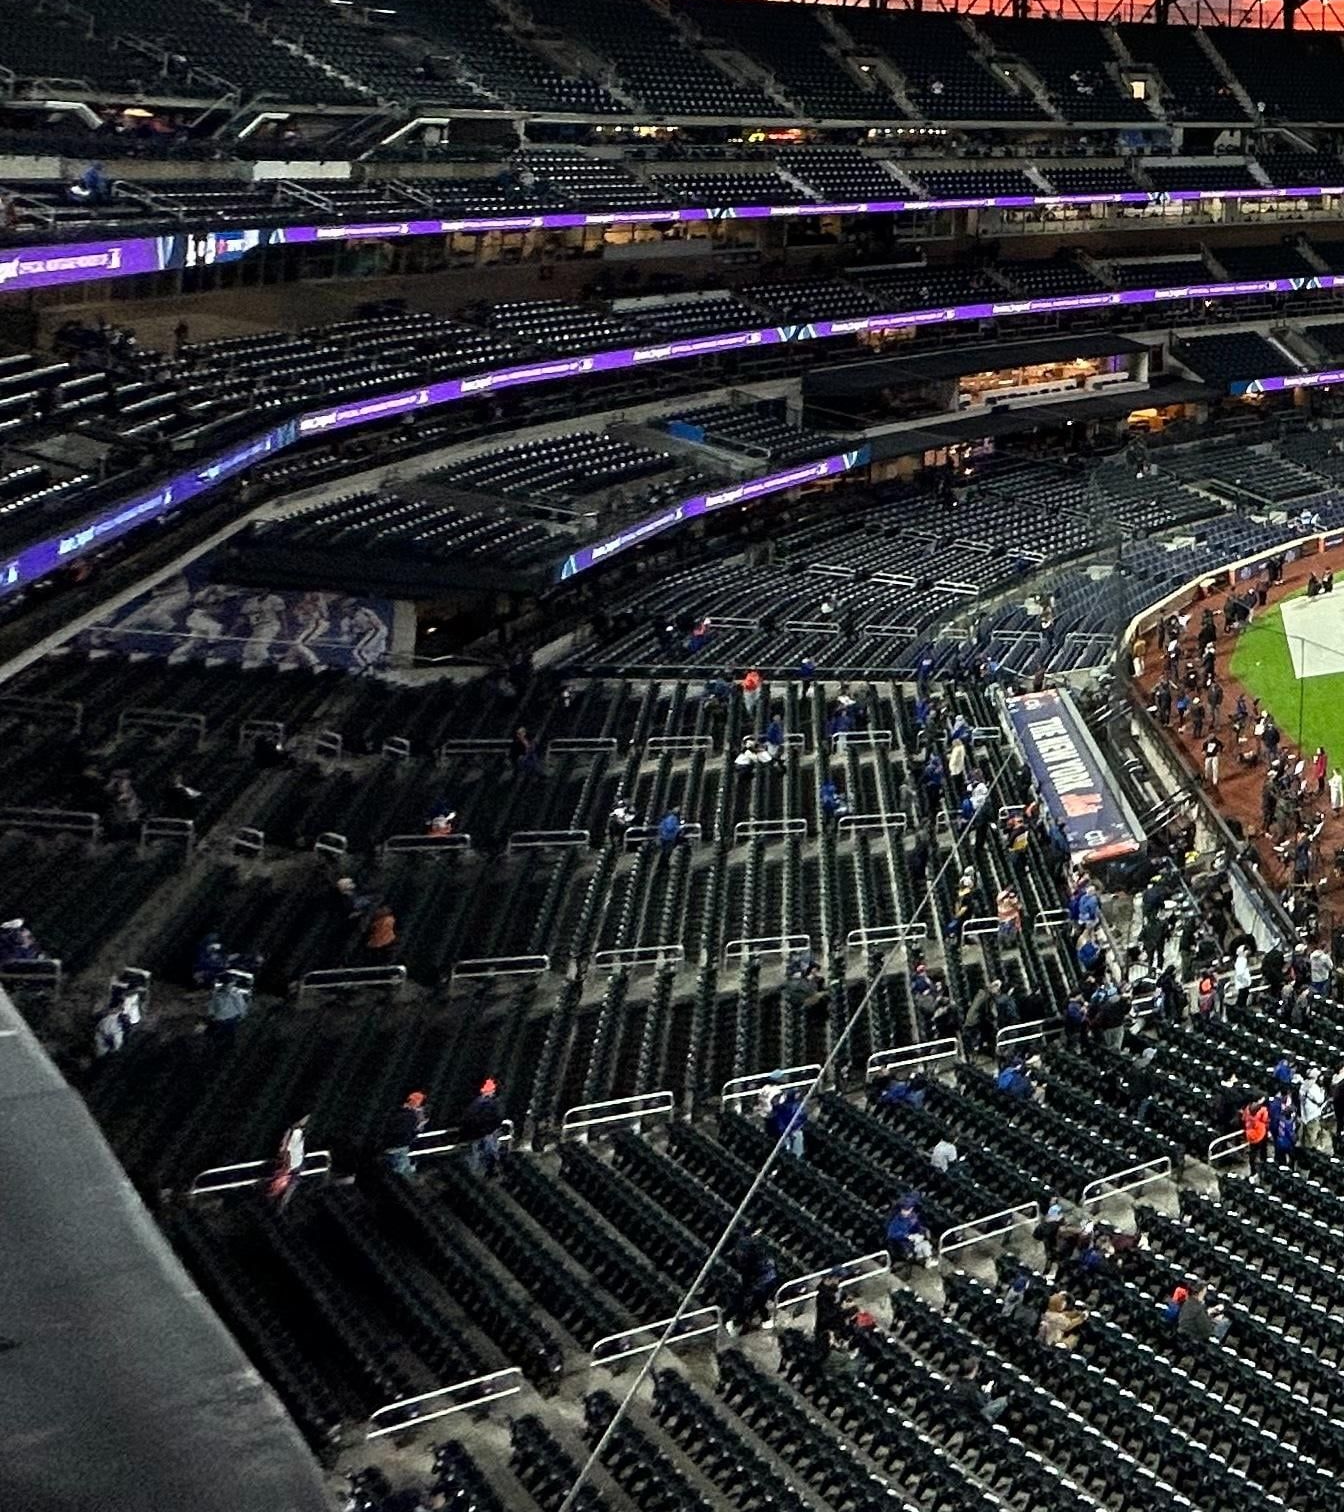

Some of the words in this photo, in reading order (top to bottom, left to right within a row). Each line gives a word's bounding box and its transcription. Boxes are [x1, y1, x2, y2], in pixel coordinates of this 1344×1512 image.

[1027, 716, 1067, 740] THE
[1036, 734, 1080, 763] NEW
[1047, 757, 1094, 794] YORK
